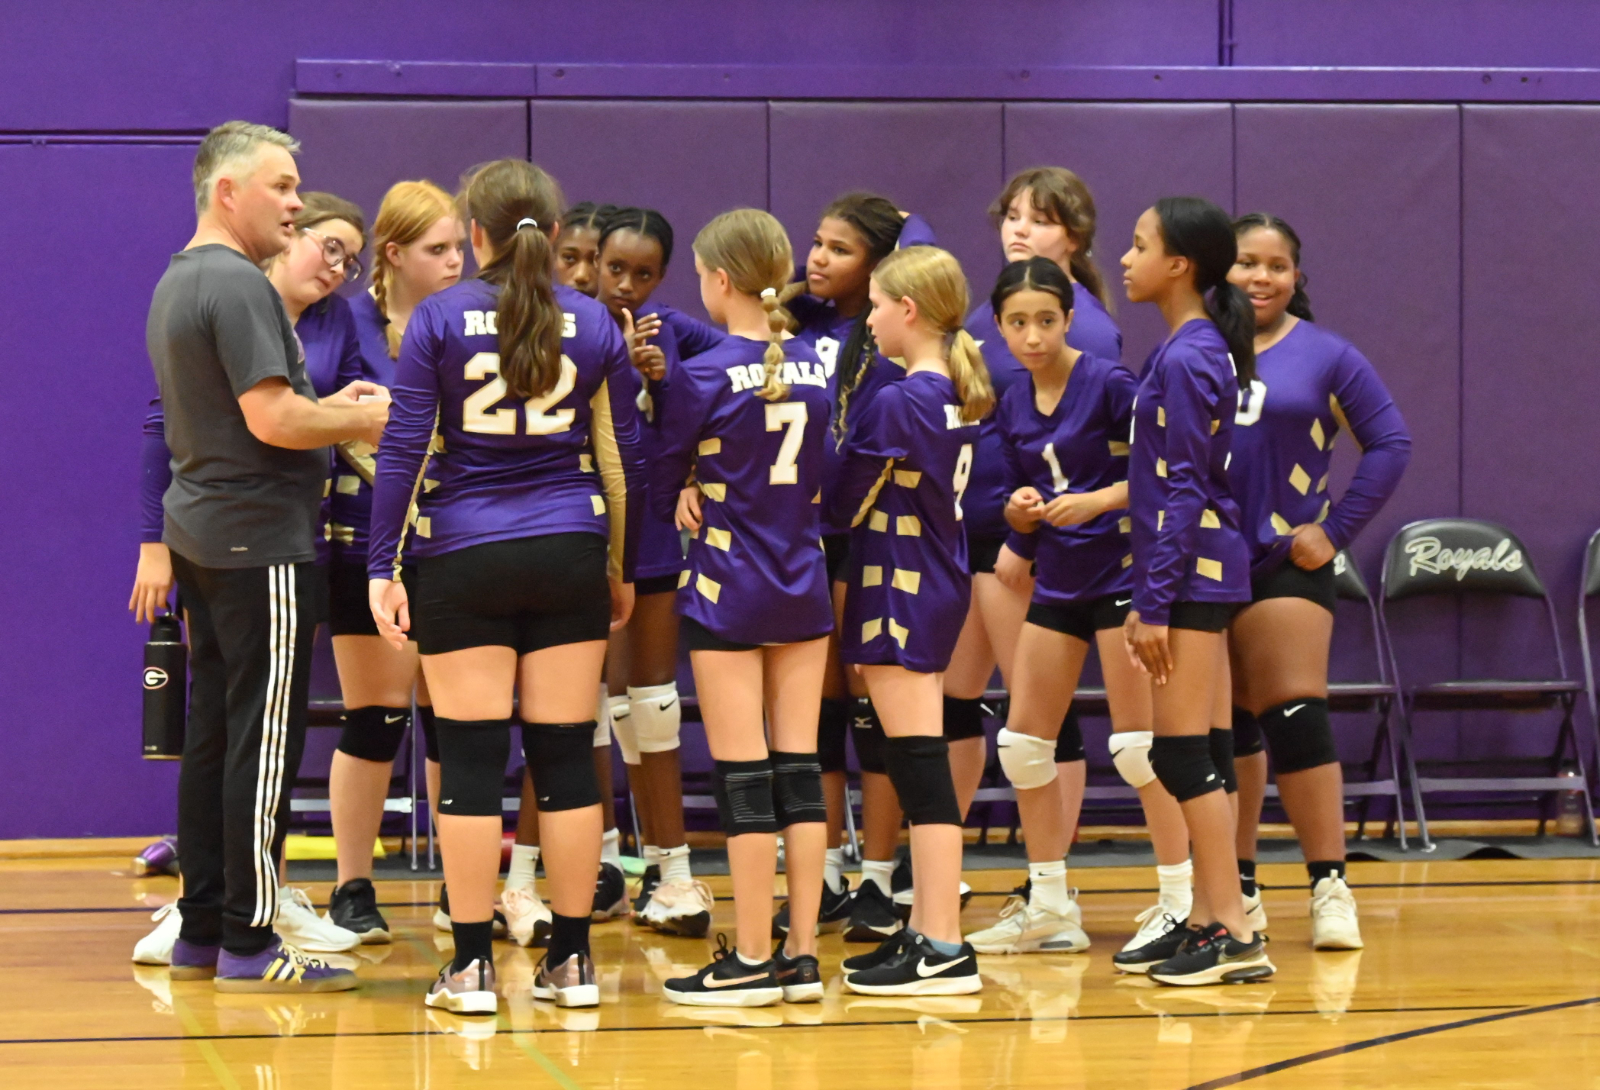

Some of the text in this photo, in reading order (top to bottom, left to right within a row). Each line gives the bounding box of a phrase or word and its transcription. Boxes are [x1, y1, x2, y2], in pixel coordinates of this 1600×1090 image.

[463, 310, 577, 338] ROS
[462, 352, 578, 436] 22
[764, 402, 808, 485] 7
[1041, 442, 1069, 493] 1
[952, 443, 973, 521] 9
[1405, 536, 1522, 581] Royals
